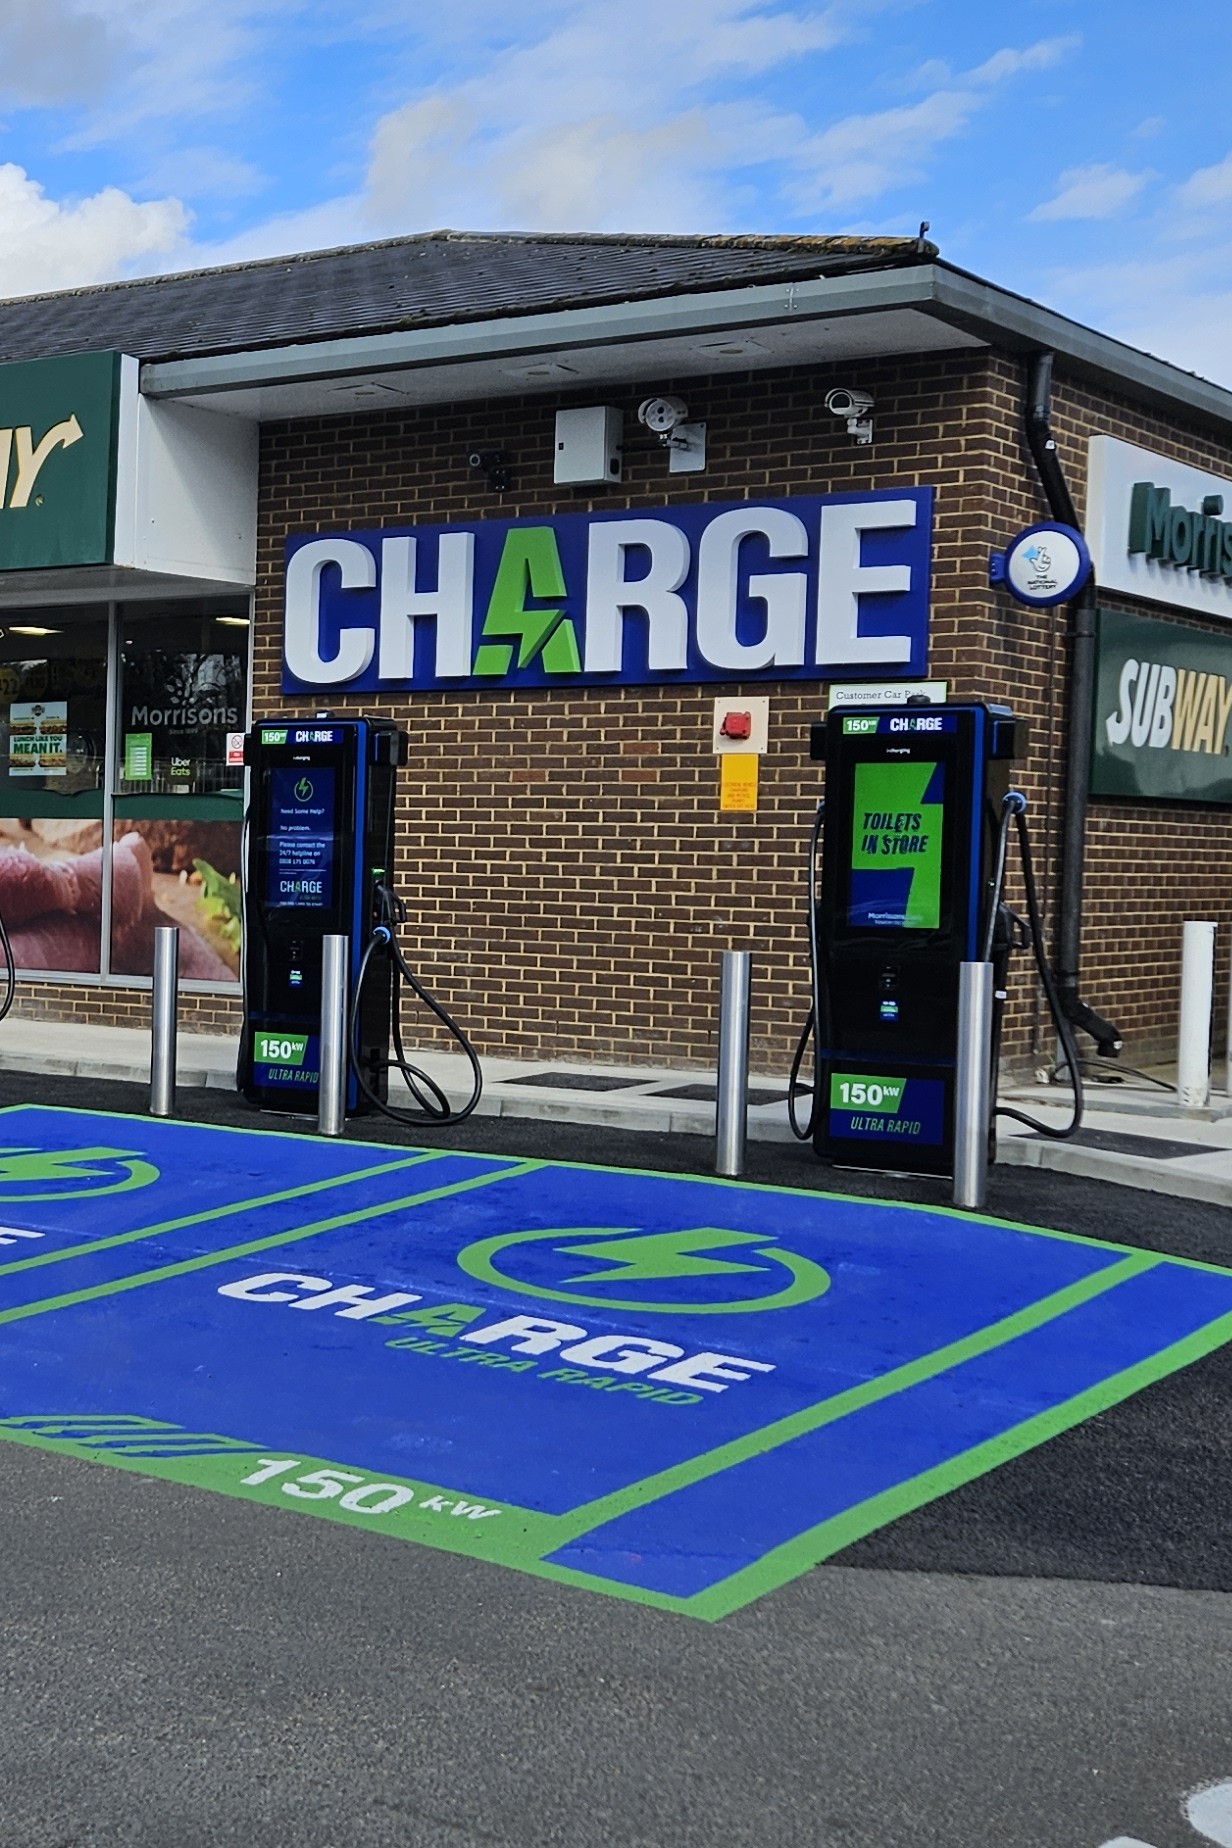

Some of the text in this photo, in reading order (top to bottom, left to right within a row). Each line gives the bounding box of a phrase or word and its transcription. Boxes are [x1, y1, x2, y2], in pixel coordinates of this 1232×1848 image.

[285, 499, 917, 684] CHARGE
[836, 690, 884, 701] Customer
[886, 690, 902, 700] Car
[131, 705, 239, 726] Morrisons
[890, 717, 942, 731] CHARGE
[295, 730, 333, 742] CHARGE
[14, 742, 62, 754] MEAN IT.
[171, 757, 190, 766] Uber
[171, 767, 190, 776] Eats
[864, 812, 922, 833] TOILETS
[862, 835, 929, 855] IN STORE
[280, 880, 322, 893] CHARGE
[269, 1068, 319, 1083] ULTRA RAPID
[851, 1116, 920, 1135] ULTRA RAPID
[218, 1272, 776, 1393] CHARGE
[384, 1336, 707, 1405] ULTRA RAPID
[239, 1458, 414, 1514] 150
